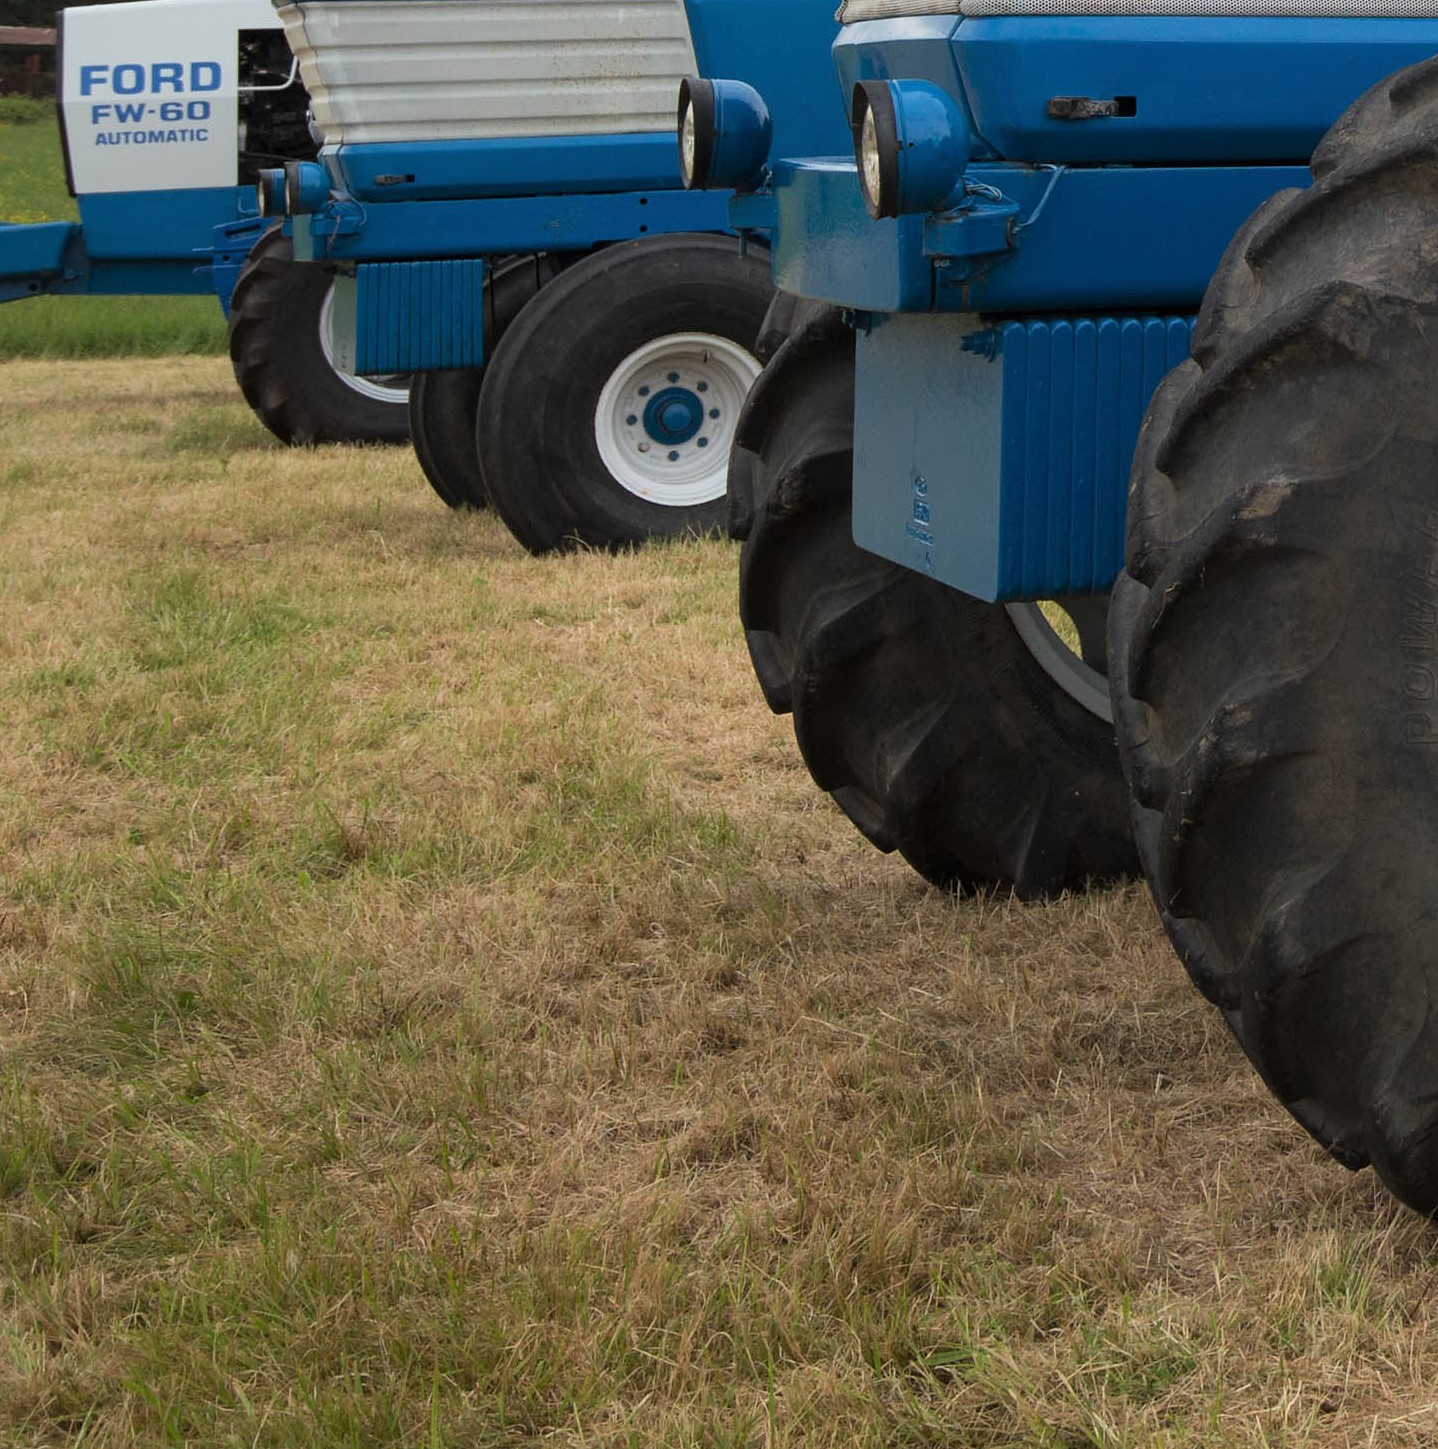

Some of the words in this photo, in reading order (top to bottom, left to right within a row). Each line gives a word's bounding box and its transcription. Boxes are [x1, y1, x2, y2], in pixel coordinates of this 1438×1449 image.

[80, 61, 222, 96] FORD
[92, 101, 211, 125] FW-60
[95, 128, 209, 146] AUTOMATIC
